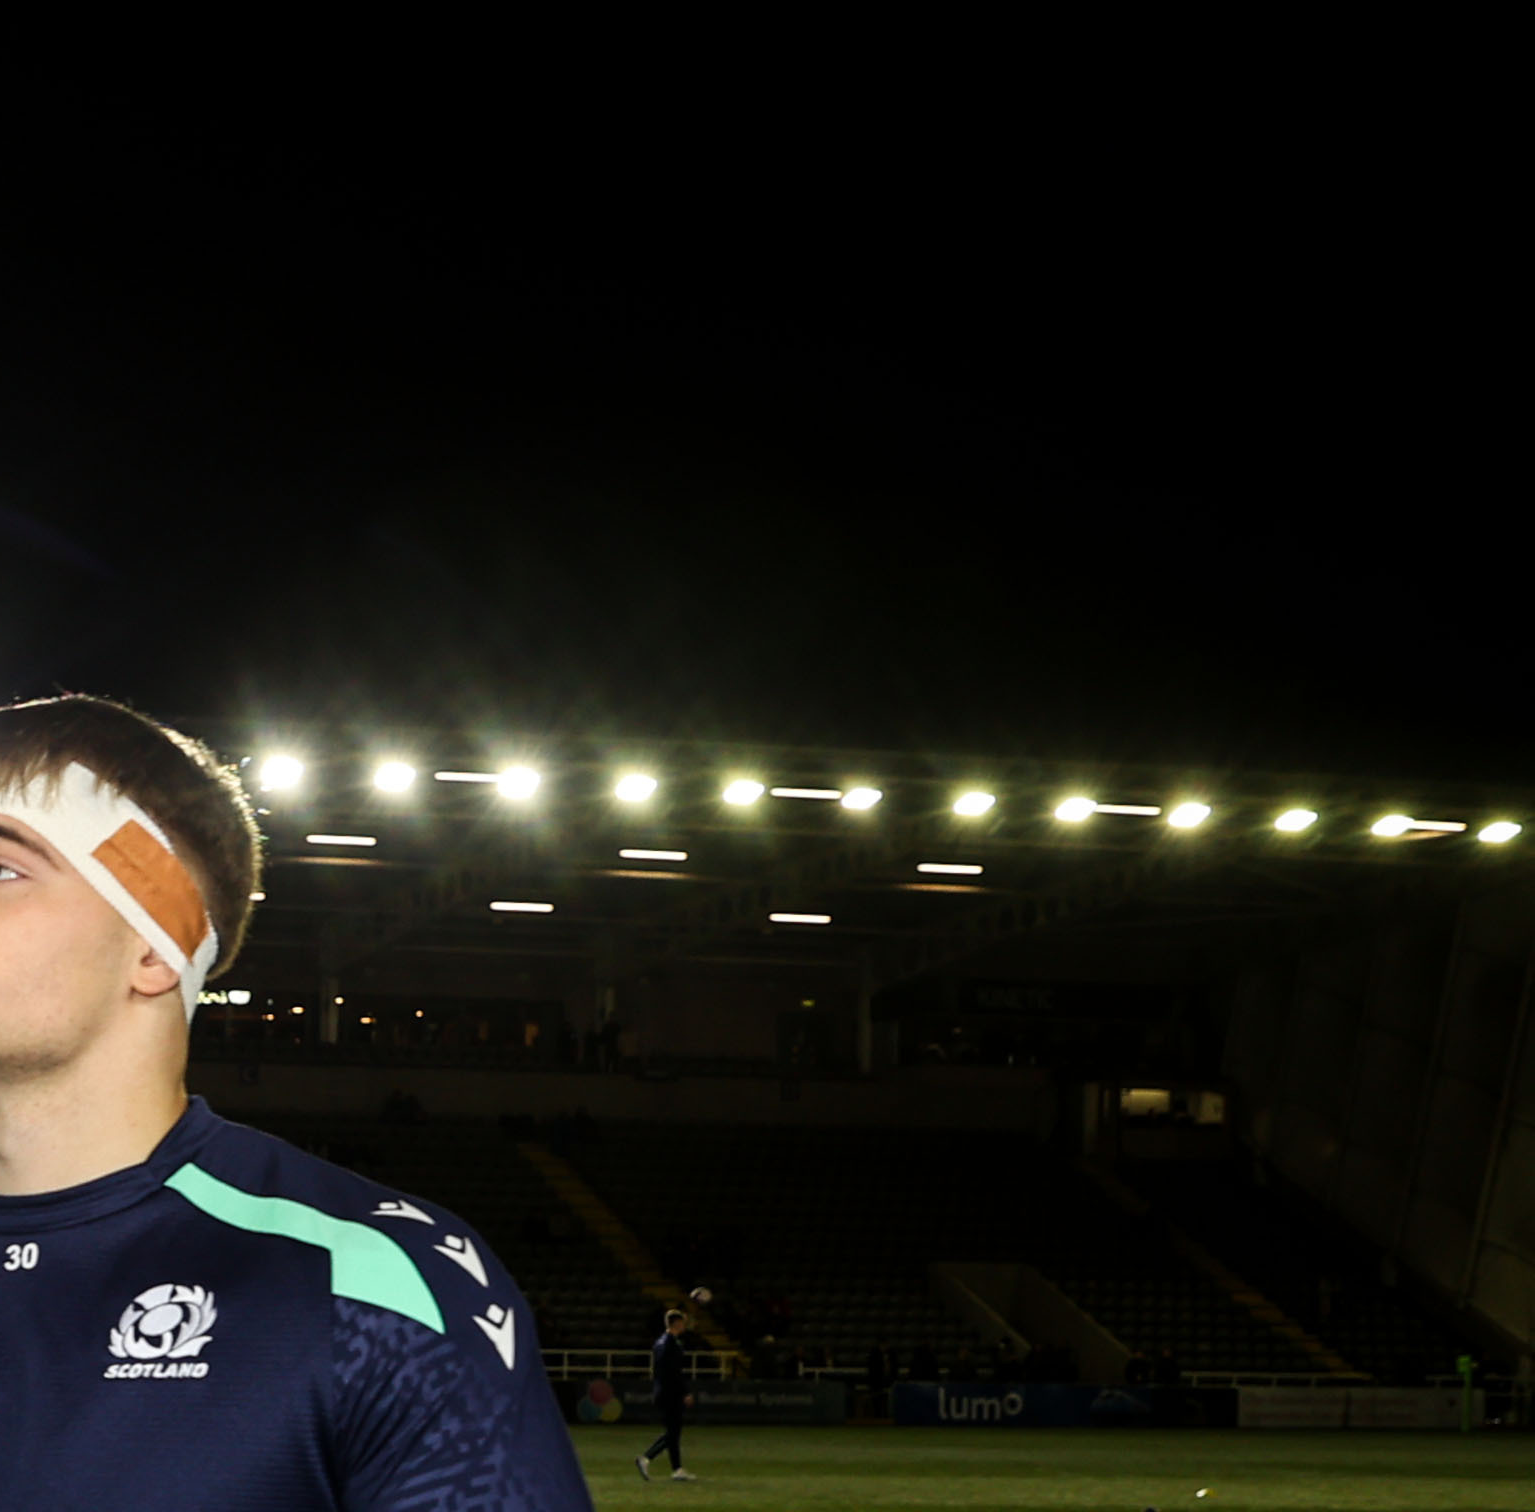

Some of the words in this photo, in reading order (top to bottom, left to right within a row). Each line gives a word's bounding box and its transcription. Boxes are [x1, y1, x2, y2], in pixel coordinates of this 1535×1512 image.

[3, 1241, 39, 1271] 30
[103, 1362, 209, 1379] SCOTLAND
[938, 1387, 1023, 1420] lumo
